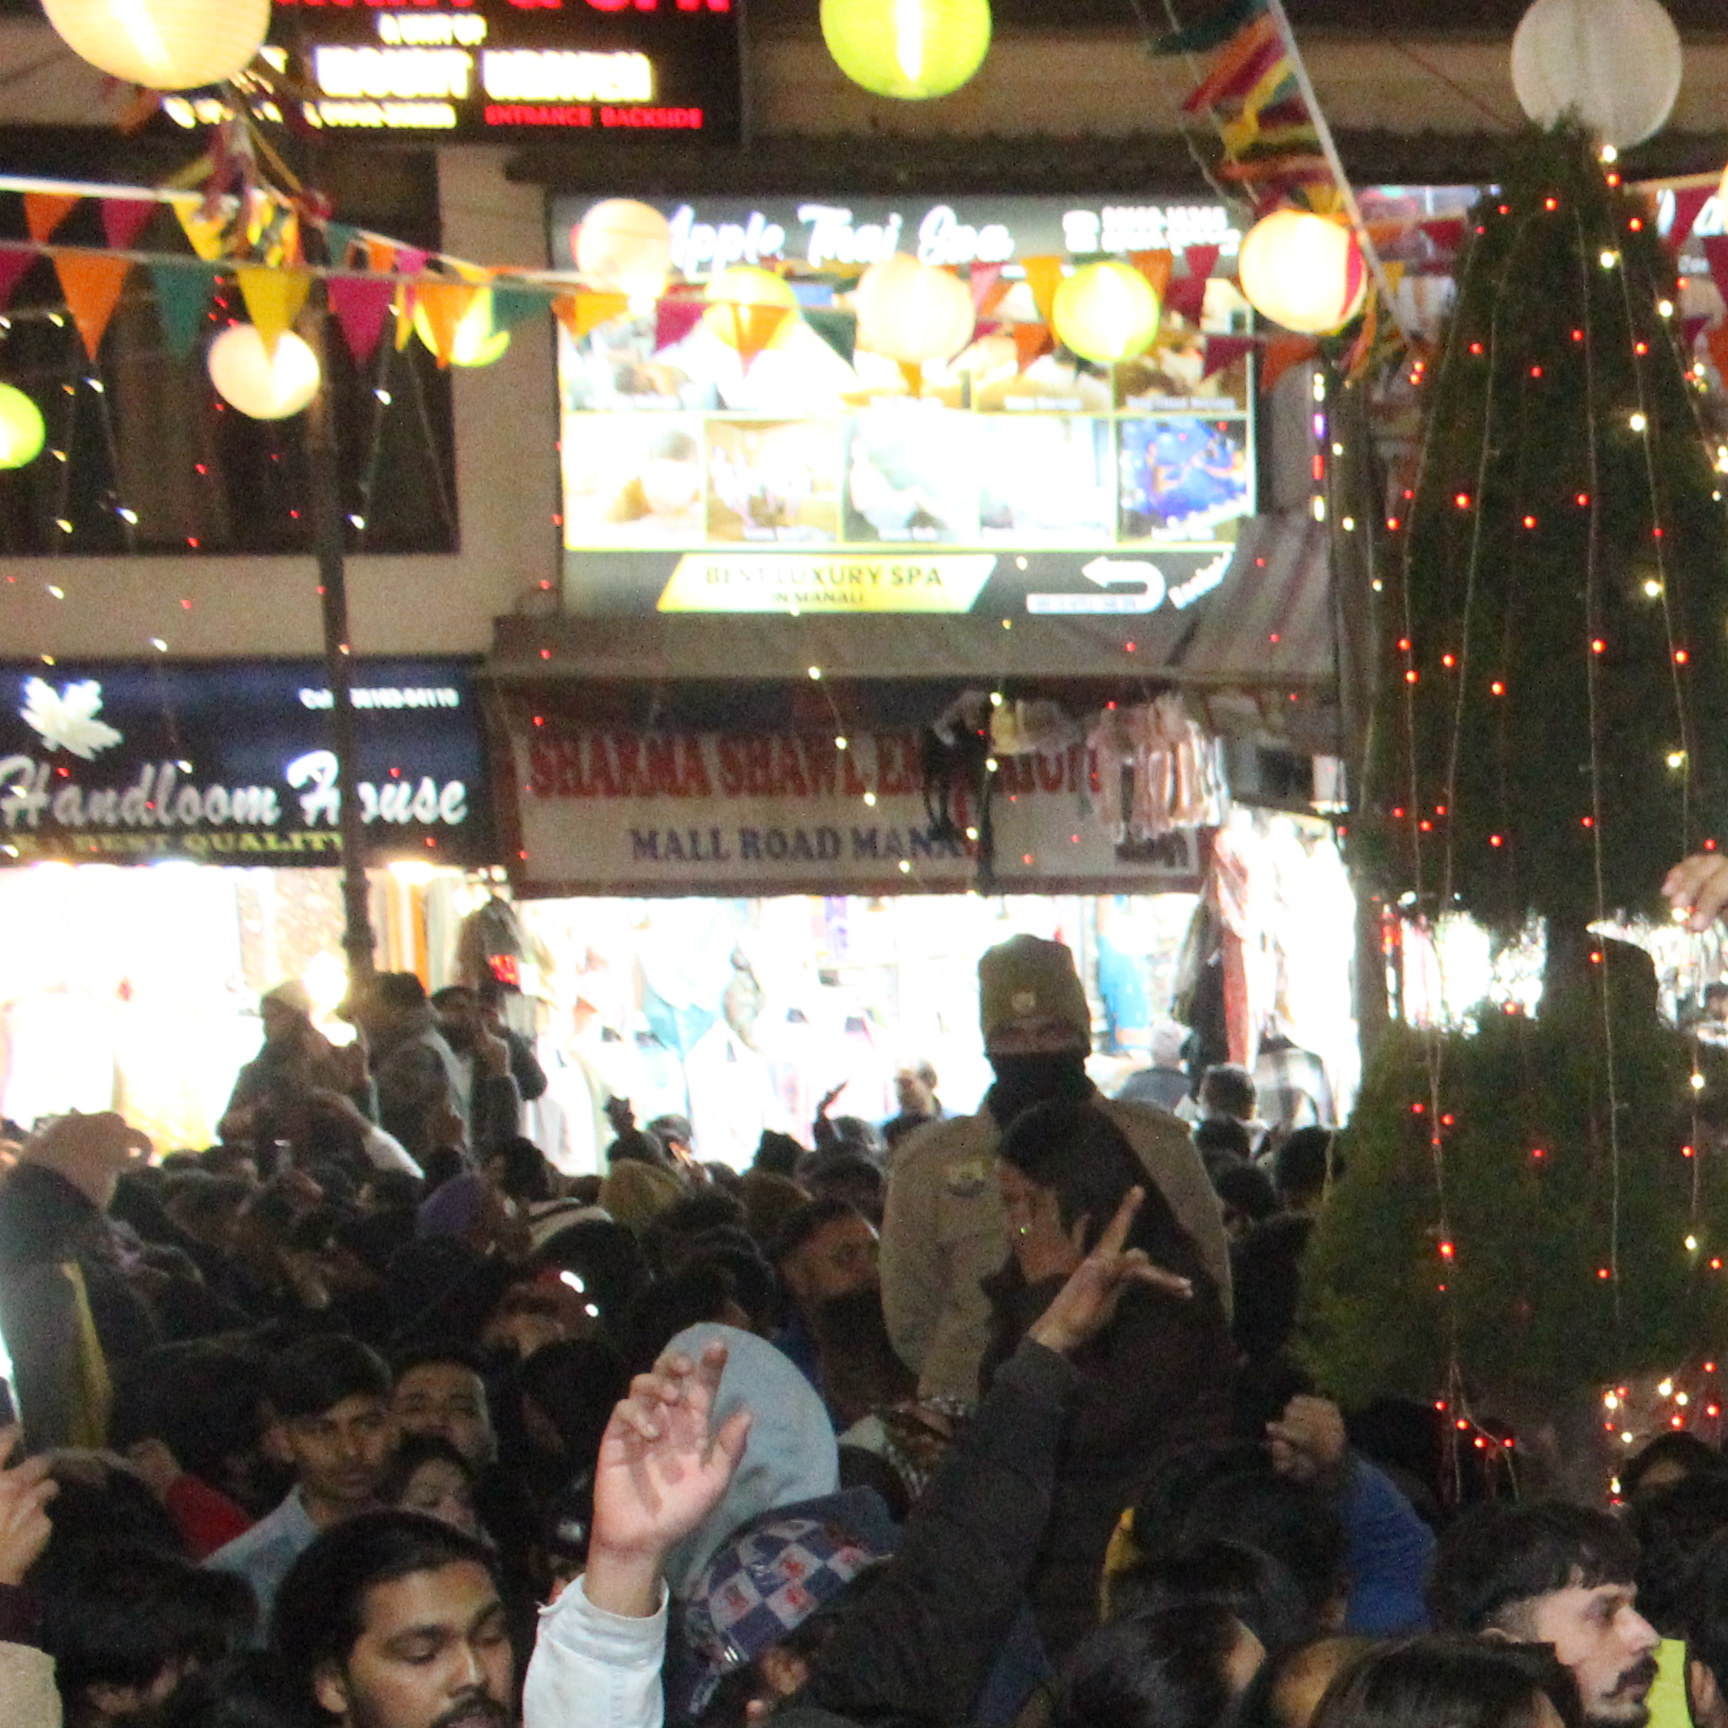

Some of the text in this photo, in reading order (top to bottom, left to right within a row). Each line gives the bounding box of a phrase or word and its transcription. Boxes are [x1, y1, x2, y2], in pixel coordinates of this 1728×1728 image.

[705, 563, 943, 588] BEST LUXURY SPA
[793, 590, 865, 605] MANALI
[527, 731, 708, 799] SHARMA
[0, 755, 281, 827] Handloom
[630, 826, 730, 861] MALL
[738, 825, 842, 861] ROAD
